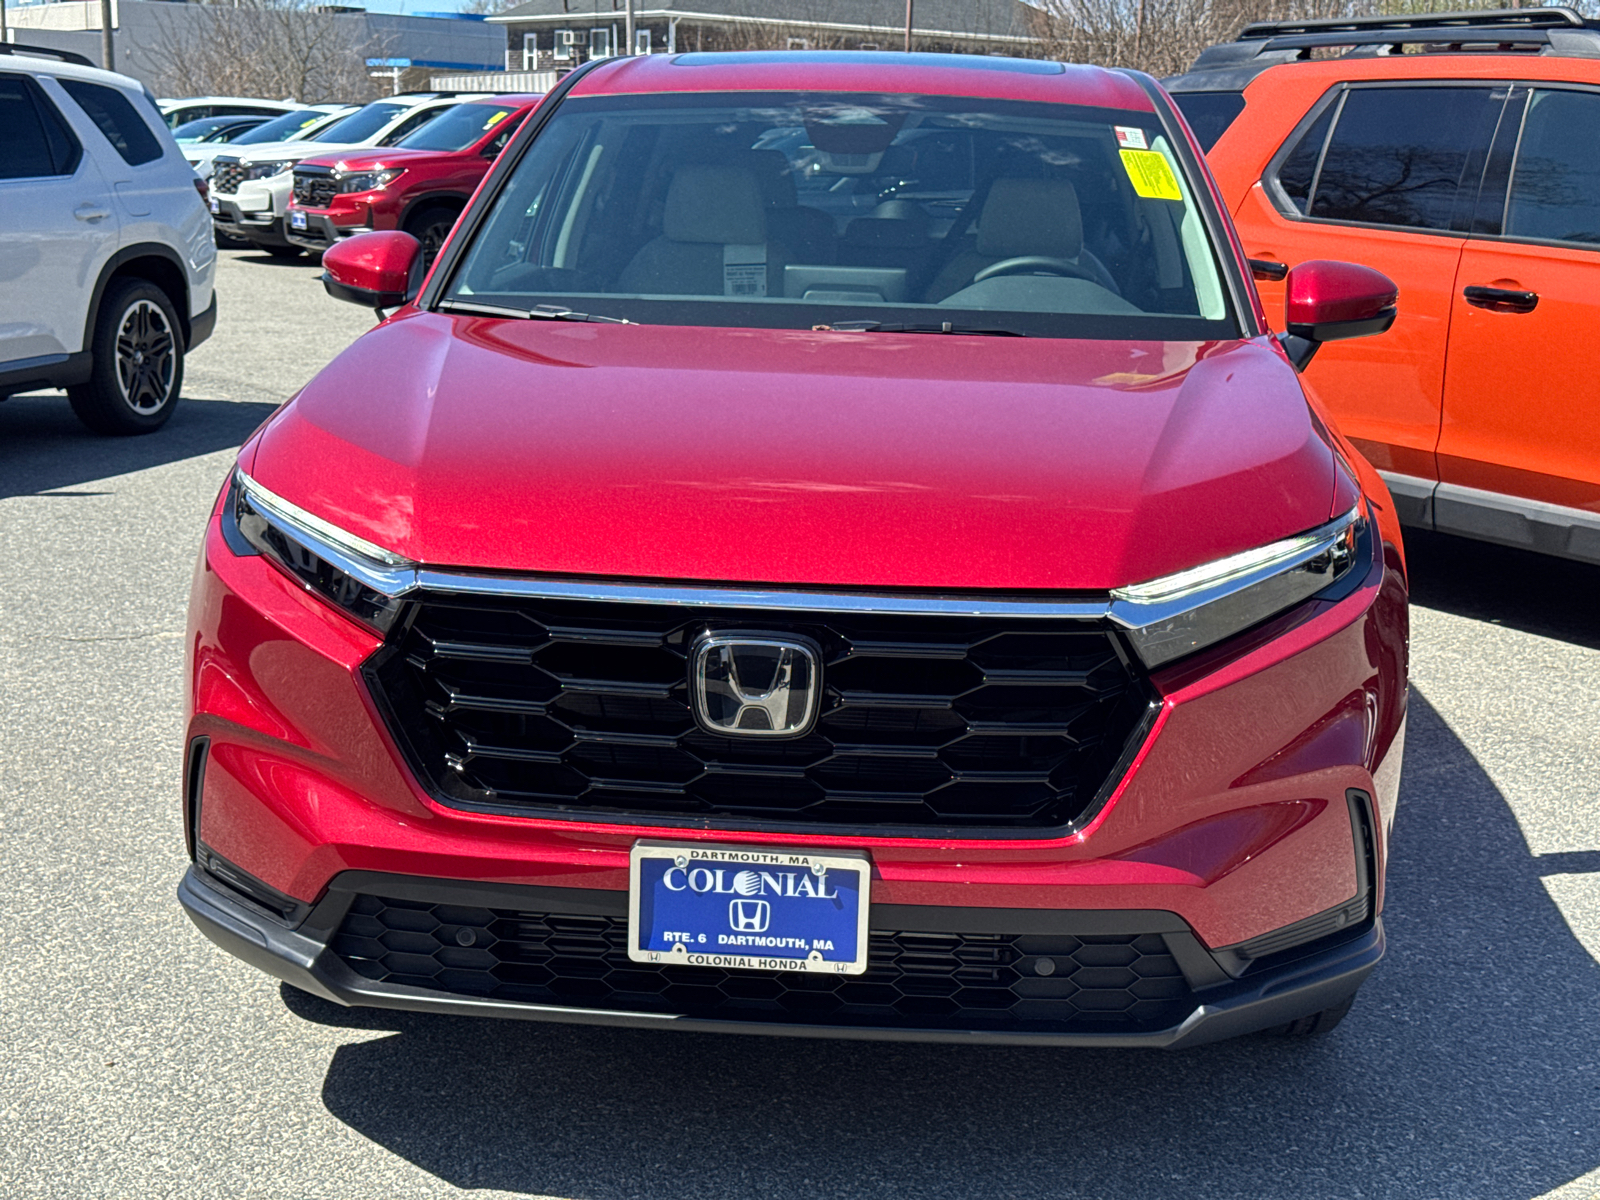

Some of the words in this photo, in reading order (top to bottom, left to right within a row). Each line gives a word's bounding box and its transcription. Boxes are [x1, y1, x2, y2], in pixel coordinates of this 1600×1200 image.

[690, 850, 784, 864] DARTMOUTH,
[788, 855, 810, 865] MA
[663, 866, 838, 899] COLONIAL
[663, 931, 694, 943] RTE.
[698, 933, 707, 943] 6
[718, 934, 809, 950] DARTMOUTH,
[813, 939, 834, 950] MA
[687, 954, 755, 968] COLONIAL
[758, 958, 807, 970] HONDA
